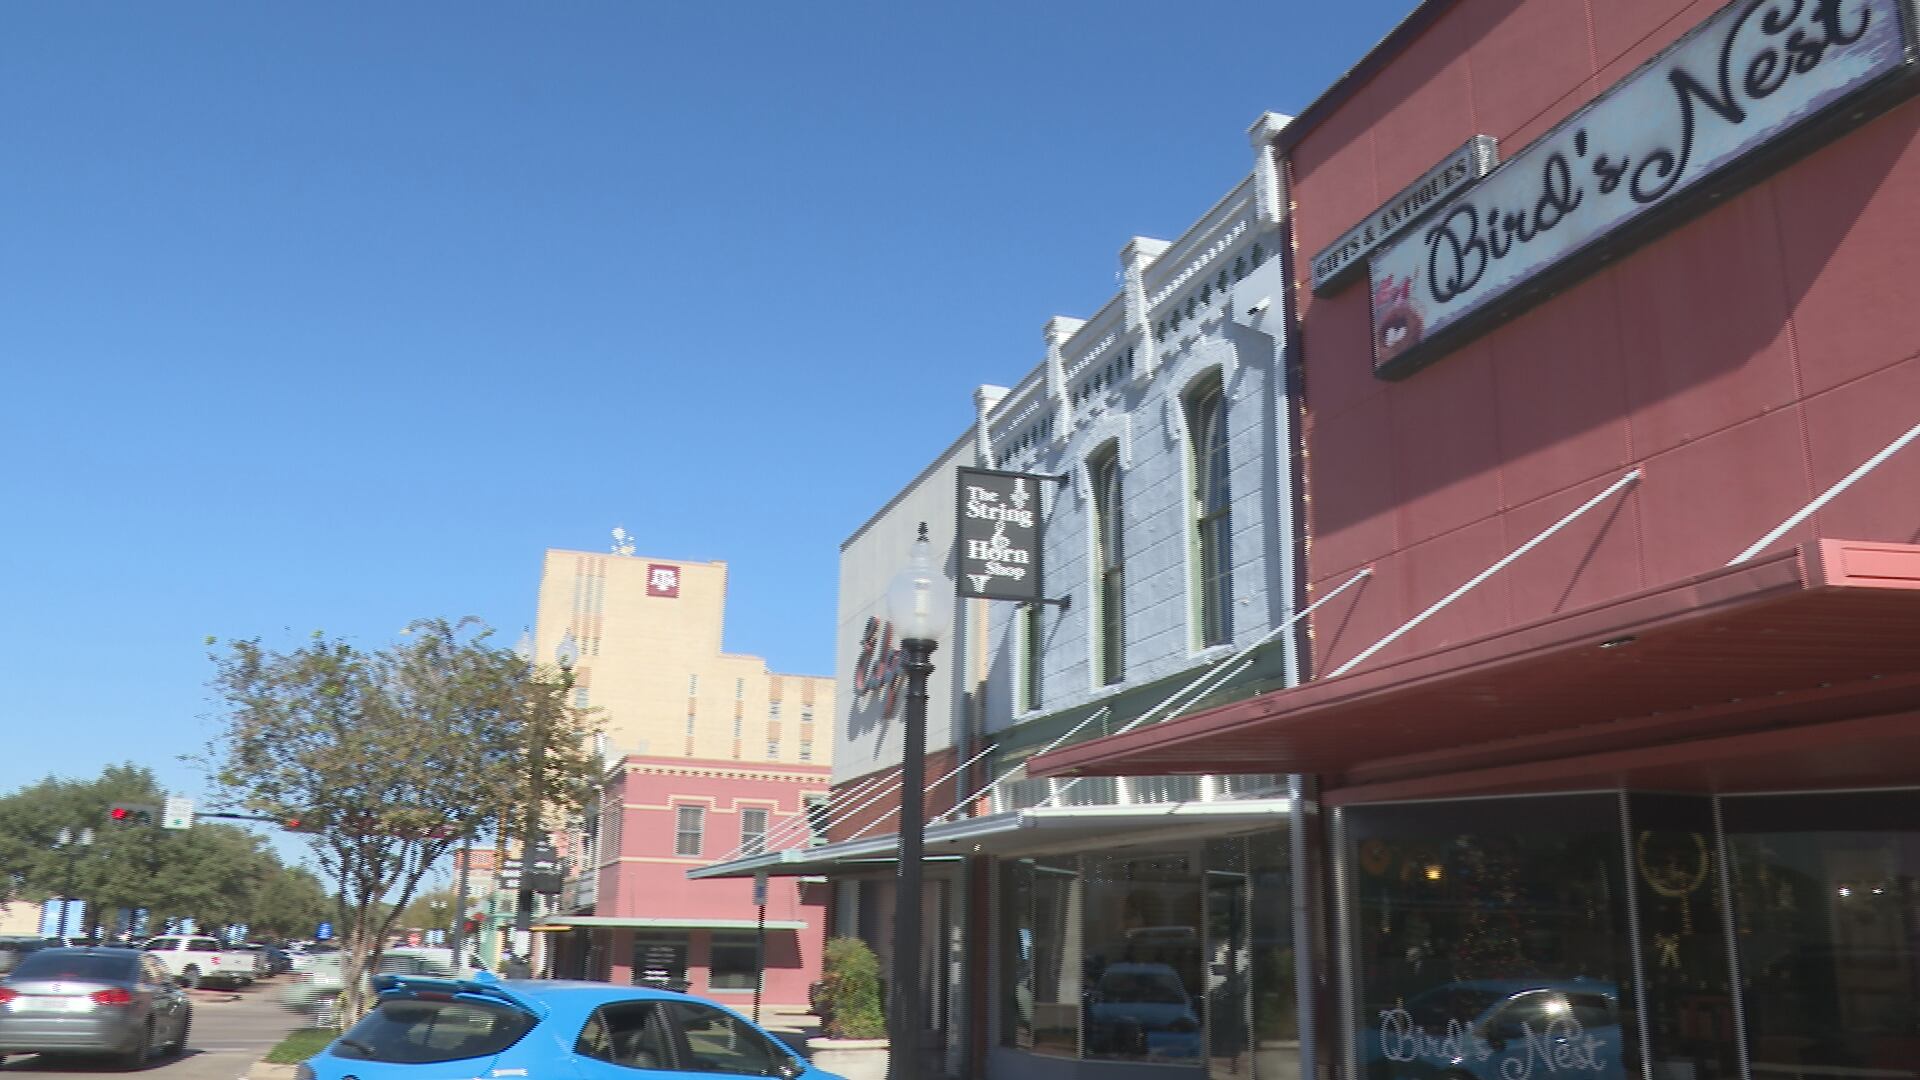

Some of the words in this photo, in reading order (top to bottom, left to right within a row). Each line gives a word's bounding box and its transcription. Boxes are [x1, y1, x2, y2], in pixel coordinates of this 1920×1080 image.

[1423, 128, 1629, 303] Bird's
[1629, 0, 1872, 204] Nest
[1316, 235, 1361, 279] GIFTS
[1363, 225, 1376, 246] &
[1379, 157, 1468, 236] ANTIQUES
[966, 485, 1000, 502] The
[965, 500, 1035, 528] String
[966, 539, 1031, 564] Horn
[985, 560, 1027, 581] Shop
[1378, 1007, 1493, 1063] Bird's
[1500, 1013, 1607, 1080] Nest
